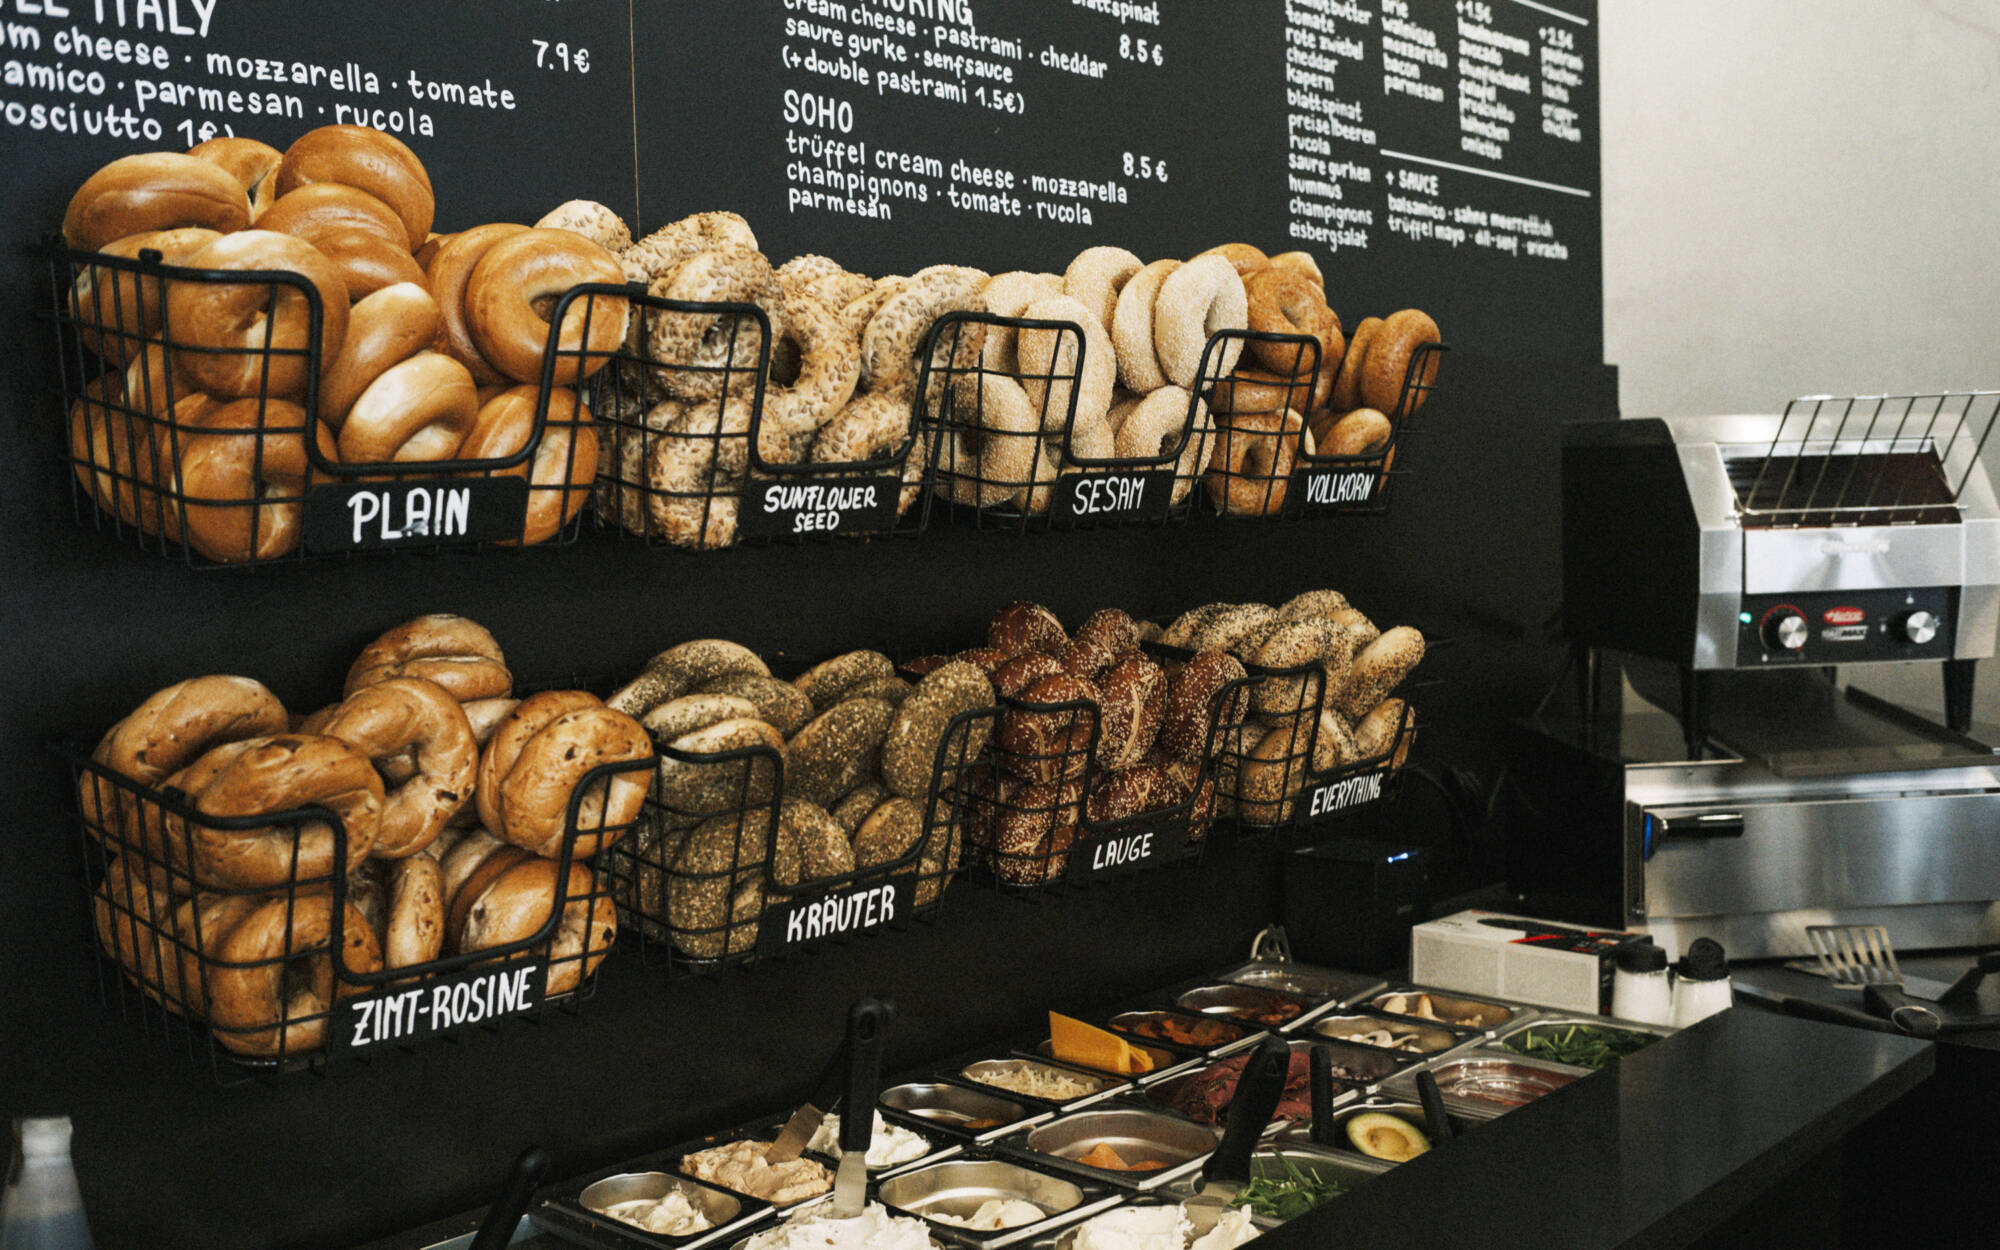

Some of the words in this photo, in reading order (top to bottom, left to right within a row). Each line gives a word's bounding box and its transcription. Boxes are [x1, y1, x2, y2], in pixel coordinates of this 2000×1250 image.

[1285, 4, 1335, 33] tomate
[532, 39, 590, 73] 7.9€
[785, 17, 843, 47] saure
[848, 34, 907, 62] gurke
[924, 48, 1013, 83] senfsauce
[851, 3, 916, 37] cheese
[934, 26, 1022, 60] pastrami
[1040, 46, 1107, 79] cheddar
[1285, 27, 1316, 49] rote
[1319, 35, 1364, 61] zwiebel
[53, 26, 170, 69] cheese
[206, 52, 379, 95] mozzarella
[408, 70, 516, 110] tomate
[1286, 45, 1338, 73] cheddar
[1383, 52, 1420, 80] bacon
[782, 45, 869, 85] (+double
[877, 71, 966, 104] pastrami
[975, 87, 1024, 114] 1.5€)
[1286, 62, 1334, 92] kapern
[1384, 74, 1444, 103] parmesan
[0, 60, 105, 96] amico
[135, 79, 303, 119] parmesan
[335, 103, 434, 137] rucola
[783, 89, 853, 133] SOHO
[1287, 87, 1363, 123] blattspinat
[1288, 113, 1376, 145] preiselbeeren
[1289, 134, 1332, 155] rucola
[786, 129, 864, 169] trüffel
[875, 149, 942, 179] cream
[951, 158, 1014, 190] cheese
[1032, 174, 1127, 205] mozzarella
[1288, 152, 1326, 176] saure
[1328, 161, 1371, 183] gurken
[1398, 169, 1439, 196] SAUCE
[787, 160, 927, 203] champignons
[947, 184, 1021, 217] tomate
[1036, 199, 1092, 226] rucola
[1288, 173, 1343, 200] hummus
[789, 187, 891, 221] parmesan
[1289, 196, 1373, 229] champignons
[1387, 193, 1446, 221] balsamico
[1289, 219, 1368, 252] eisbergsalat
[1387, 214, 1433, 241] trüffel
[763, 484, 877, 513] SUNFLOWER
[1072, 476, 1145, 515] SESAM
[1306, 473, 1375, 503] VOLLKORN
[347, 487, 470, 543] PLAIN
[793, 511, 840, 533] SEED
[1310, 772, 1383, 816] EVERYTHING
[1092, 832, 1154, 870] LAUGE
[786, 884, 895, 943] KRÄUTER
[350, 966, 536, 1047] ZIMT-ROSINE
